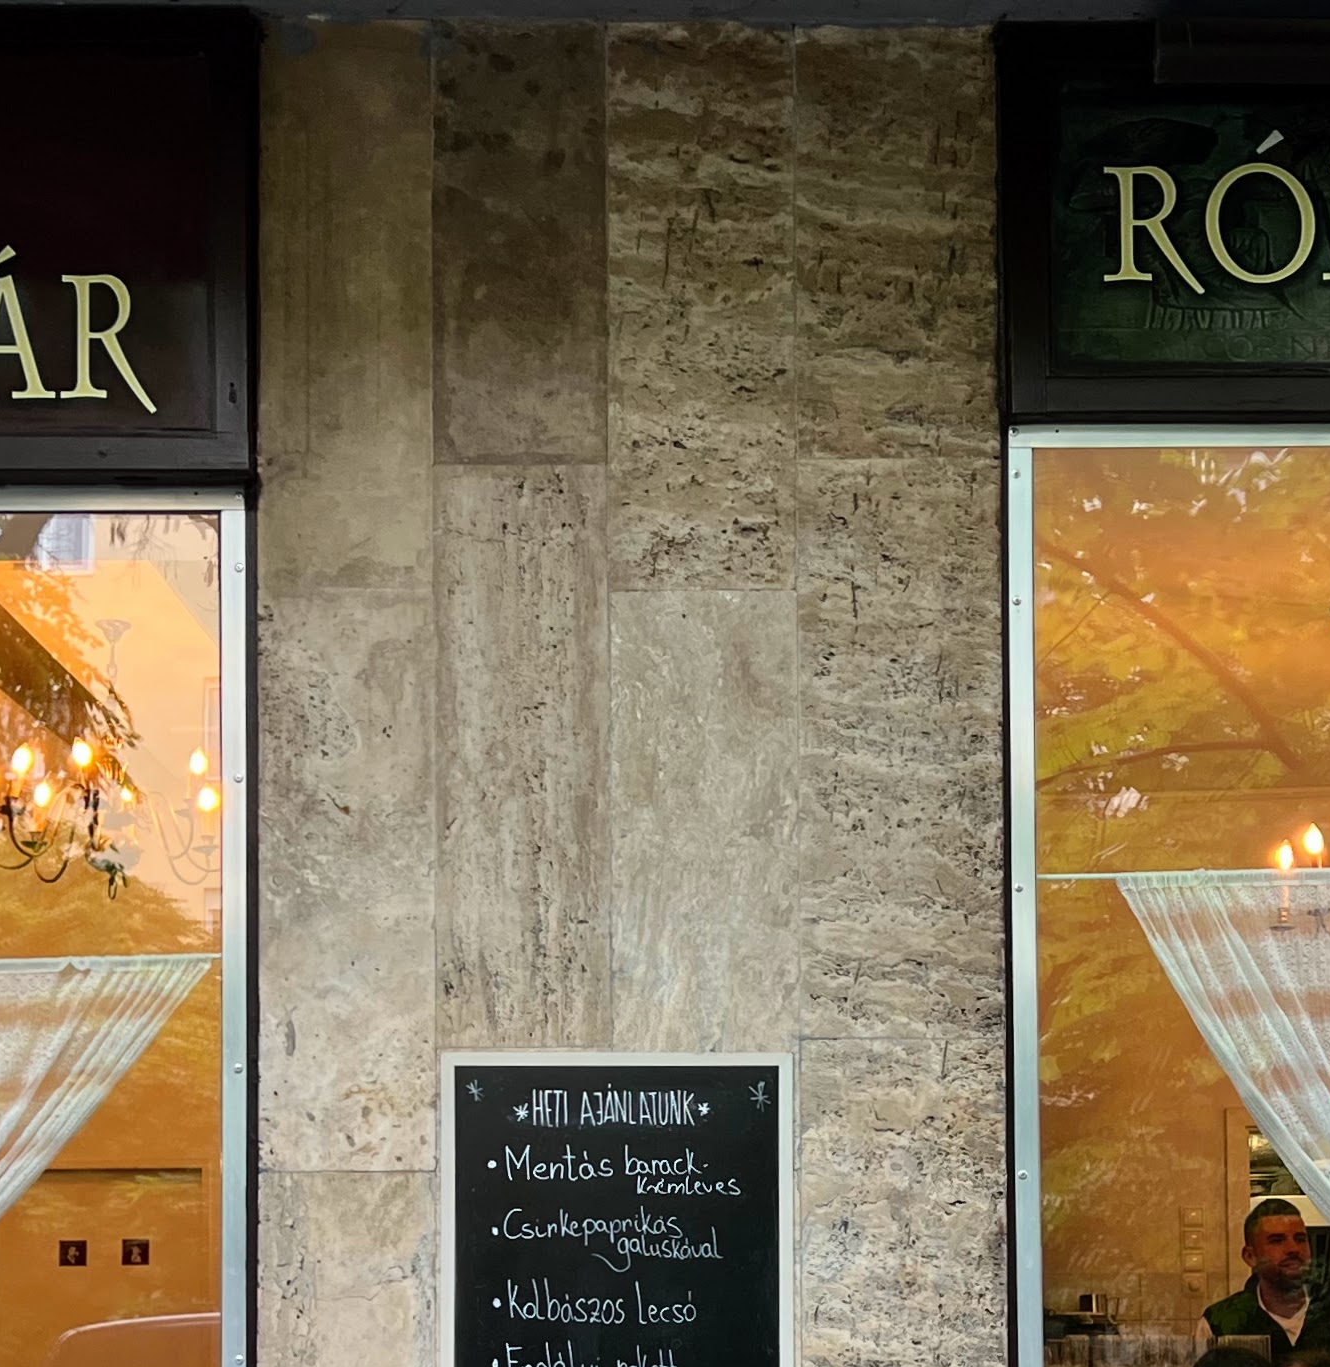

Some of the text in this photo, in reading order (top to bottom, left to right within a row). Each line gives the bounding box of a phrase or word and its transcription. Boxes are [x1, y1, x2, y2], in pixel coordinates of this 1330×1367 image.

[532, 1083, 695, 1127] HETI AJÁNLATUNK
[505, 1144, 614, 1181] Mentás
[502, 1206, 684, 1247] Csirkepaprikás
[507, 1277, 697, 1325] Kolbászos lecsó
